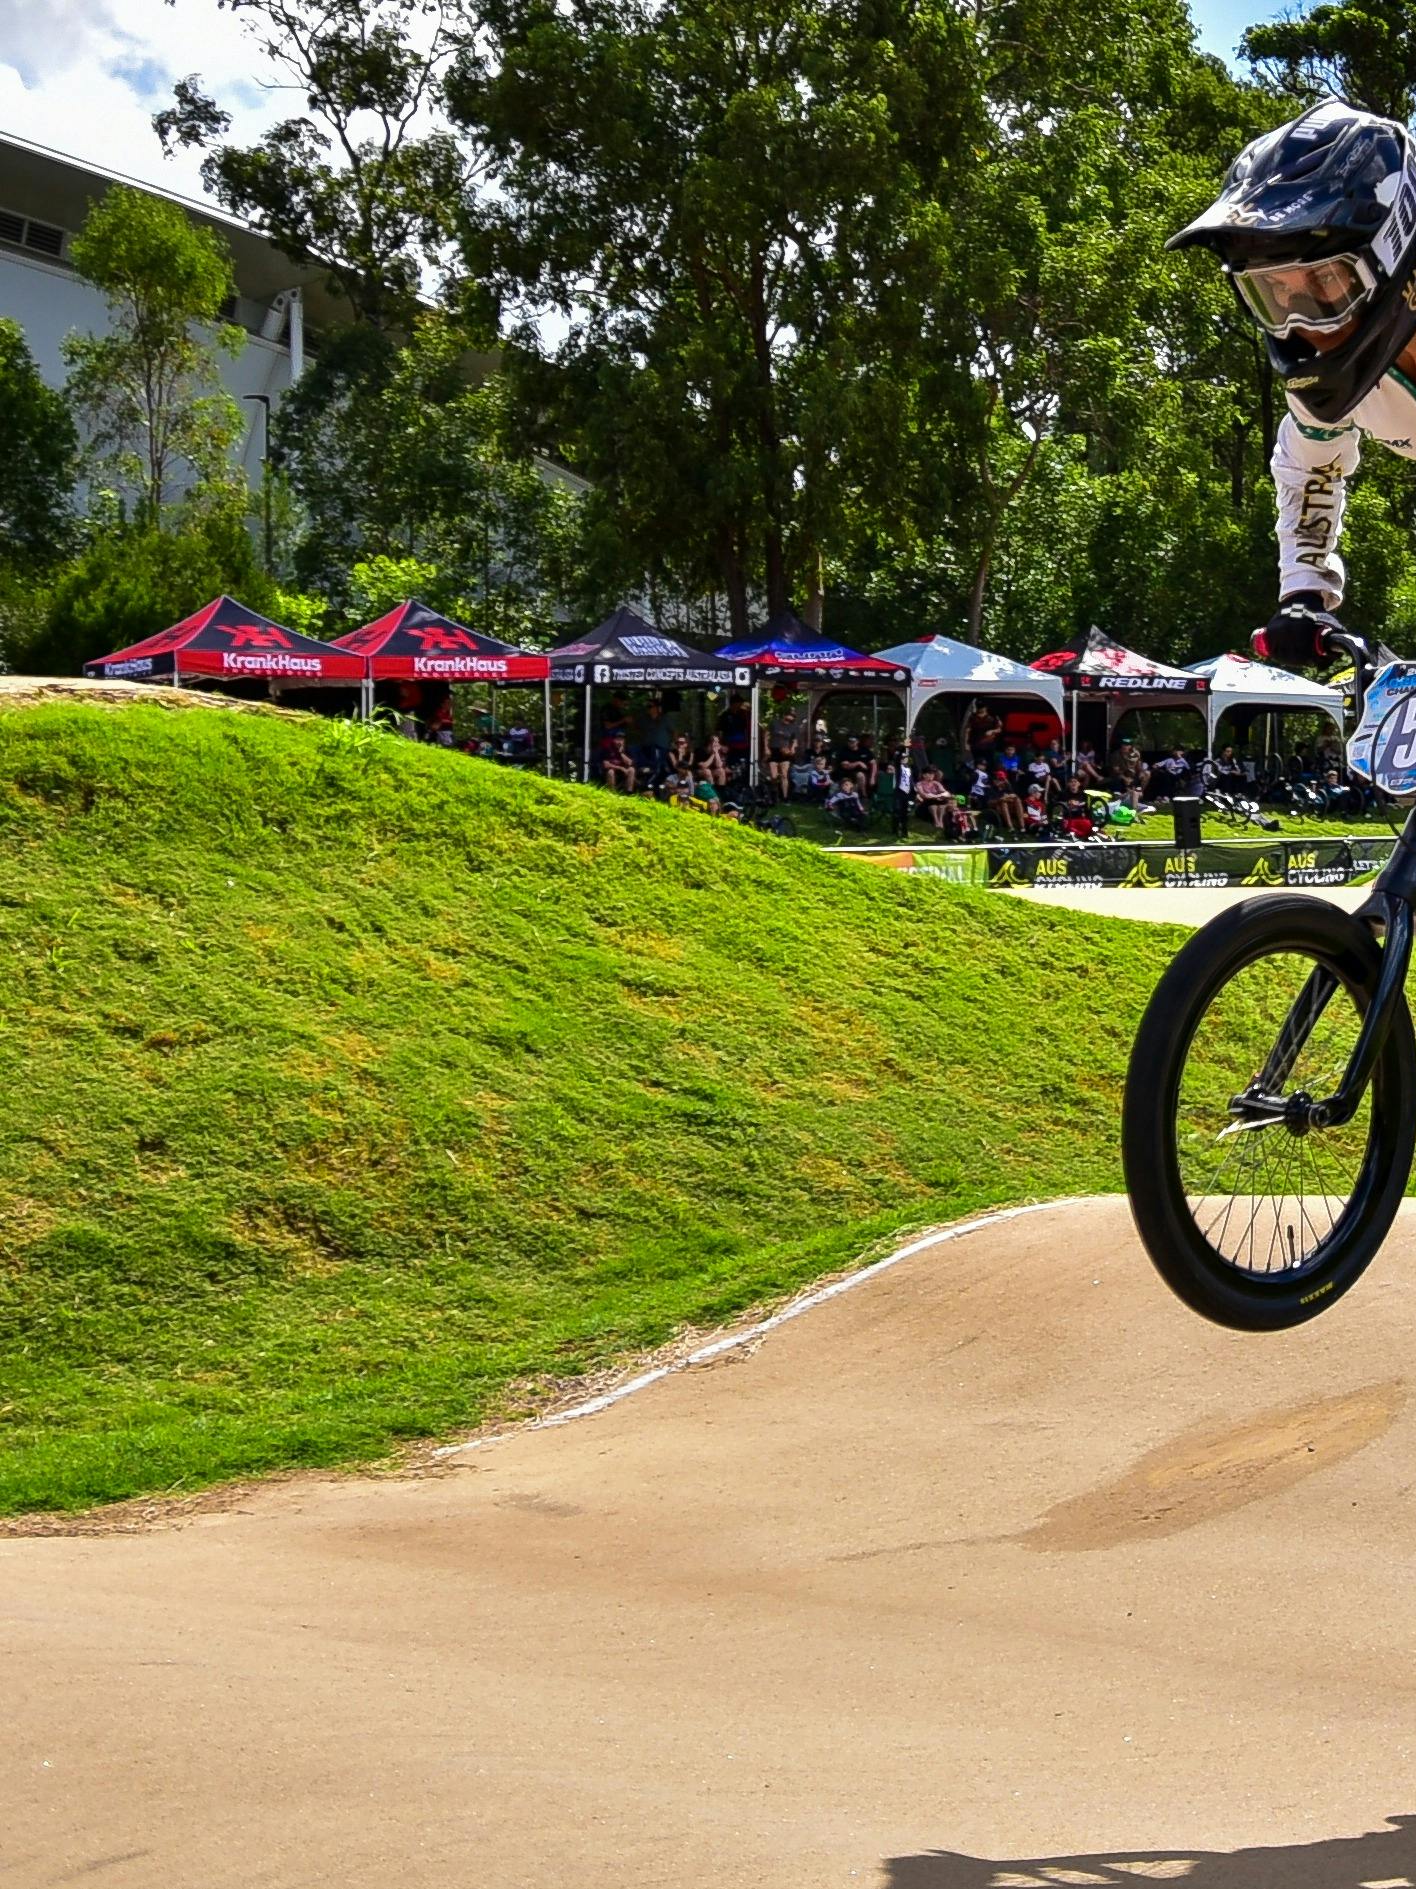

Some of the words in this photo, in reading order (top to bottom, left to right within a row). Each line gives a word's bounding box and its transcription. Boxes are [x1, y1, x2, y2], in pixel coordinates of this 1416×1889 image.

[223, 653, 322, 671] KrankHaus
[413, 657, 508, 672] KrankHaus
[1099, 677, 1187, 690] REDLINE
[1036, 859, 1067, 876] AUS
[1165, 856, 1197, 873] AUS
[1288, 853, 1316, 869] AUS
